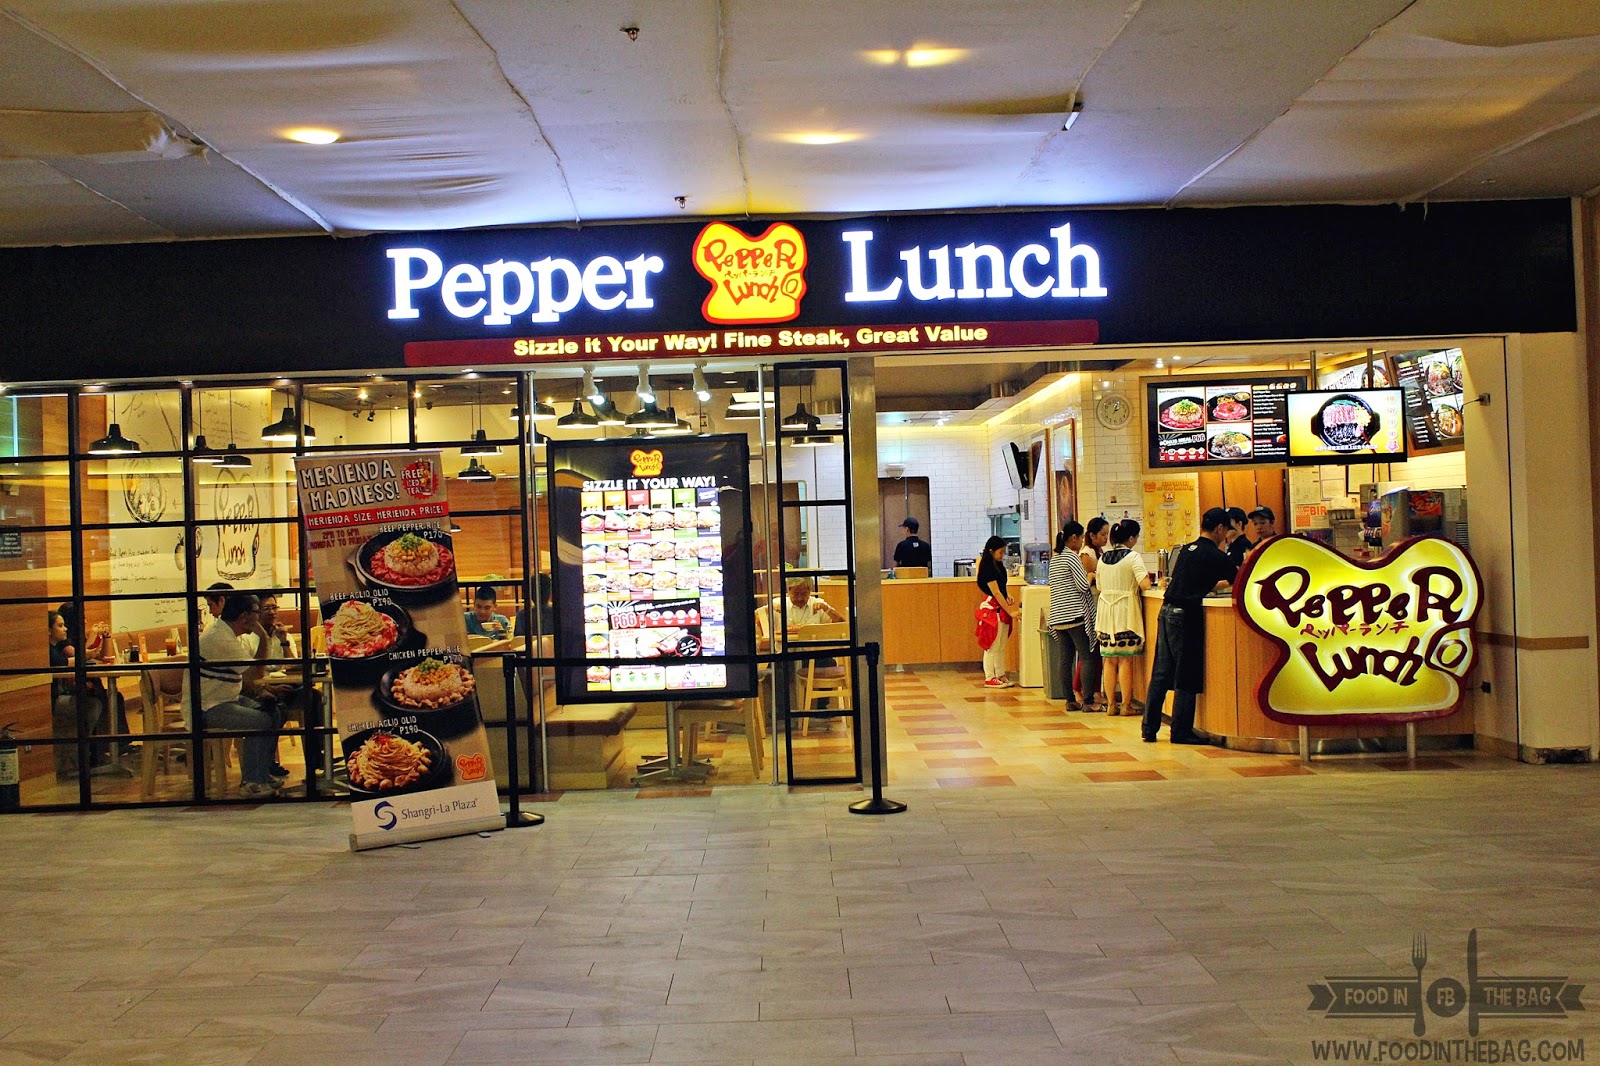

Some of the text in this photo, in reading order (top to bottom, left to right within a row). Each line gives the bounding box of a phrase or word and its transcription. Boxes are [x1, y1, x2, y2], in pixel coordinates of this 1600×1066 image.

[842, 222, 1108, 302] Lunch
[386, 247, 664, 326] Pepper
[513, 326, 988, 356] Sizzle it Your Way! Fine Steak, Great Value
[301, 459, 396, 490] MERIENDA
[401, 469, 422, 480] FREE
[582, 475, 716, 492] SIZZLE IT YOUR WAY!
[308, 481, 400, 512] MADNESS!
[308, 514, 351, 526] MERIENDA
[376, 508, 417, 520] MERIENDA
[419, 505, 445, 516] PRICE!
[379, 521, 441, 533] BEEF PEPPER RICE
[423, 530, 443, 539] P170
[350, 589, 371, 599] AGLIO
[372, 588, 389, 597] OLIO
[611, 612, 637, 630] P66
[388, 650, 416, 660] CHICKEN
[417, 647, 444, 657] PEPPER
[1299, 636, 1424, 693] Lunch
[348, 715, 417, 732] CHICKEN AGLIO OLIO
[400, 724, 419, 735] P190
[401, 798, 477, 820] Shangri-La Plaza
